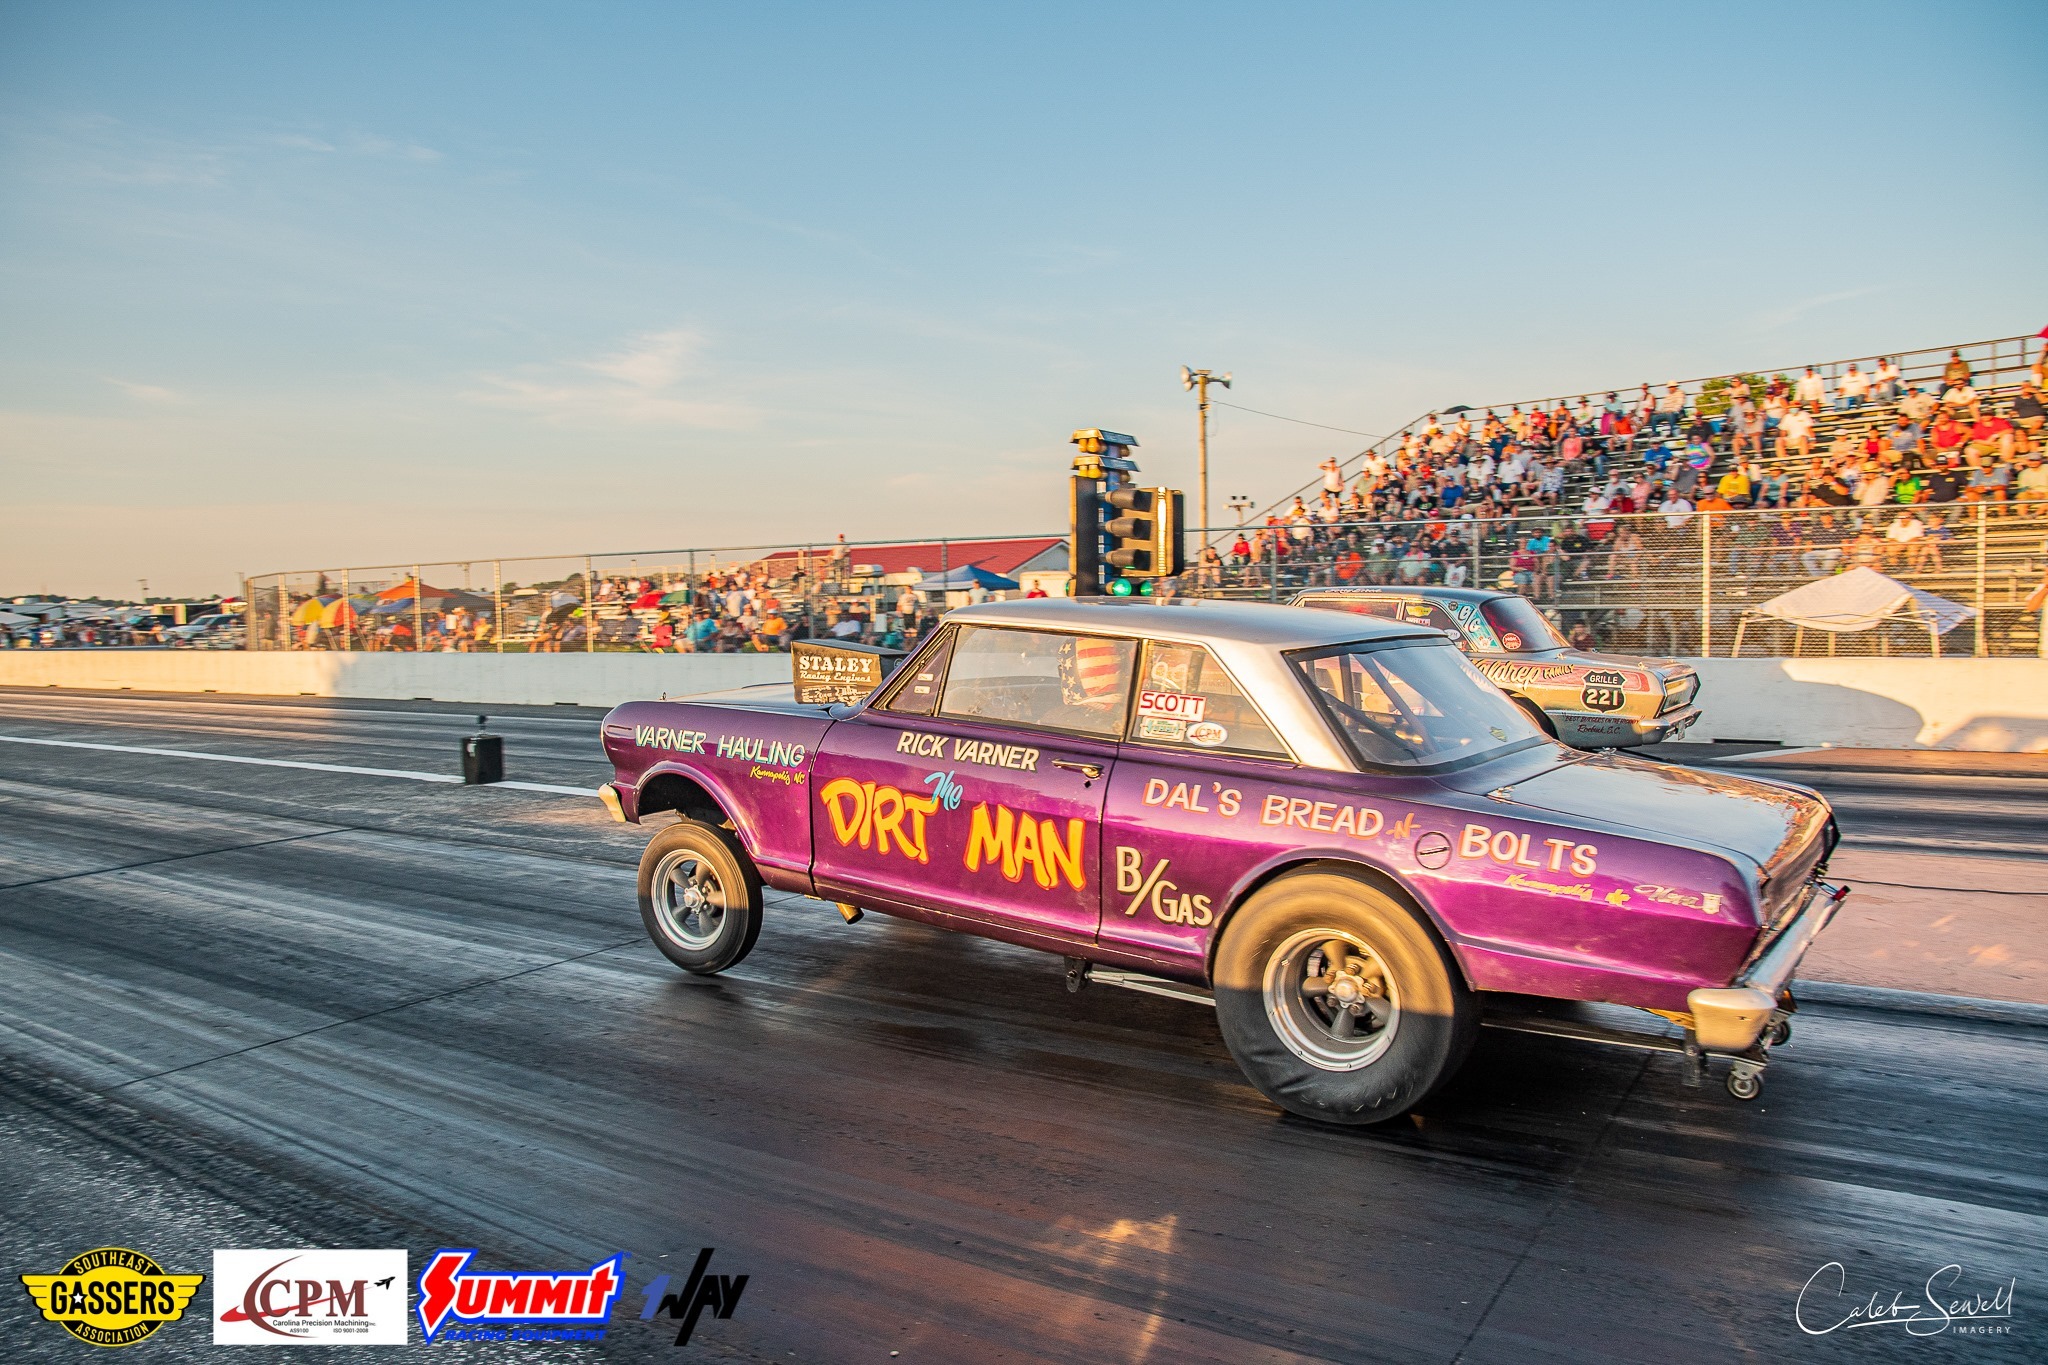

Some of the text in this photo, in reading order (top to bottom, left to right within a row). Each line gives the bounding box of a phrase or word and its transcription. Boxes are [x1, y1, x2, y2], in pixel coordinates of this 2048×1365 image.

[800, 656, 872, 673] STALEY
[1543, 664, 1574, 679] FAMILY
[800, 671, 871, 683] Racing Engines
[1590, 675, 1618, 685] GRILLE
[1140, 693, 1204, 714] SCOTT
[1587, 689, 1619, 706] 221
[635, 725, 806, 767] VARNER HAULING
[896, 731, 1040, 772] RICK VARNER
[794, 772, 805, 785] NC
[924, 770, 963, 811] The
[820, 777, 1087, 891] DIRT MAN
[1142, 778, 1243, 818] DAL'S
[1259, 795, 1384, 840] BREAD
[1458, 823, 1598, 878] BOLTS
